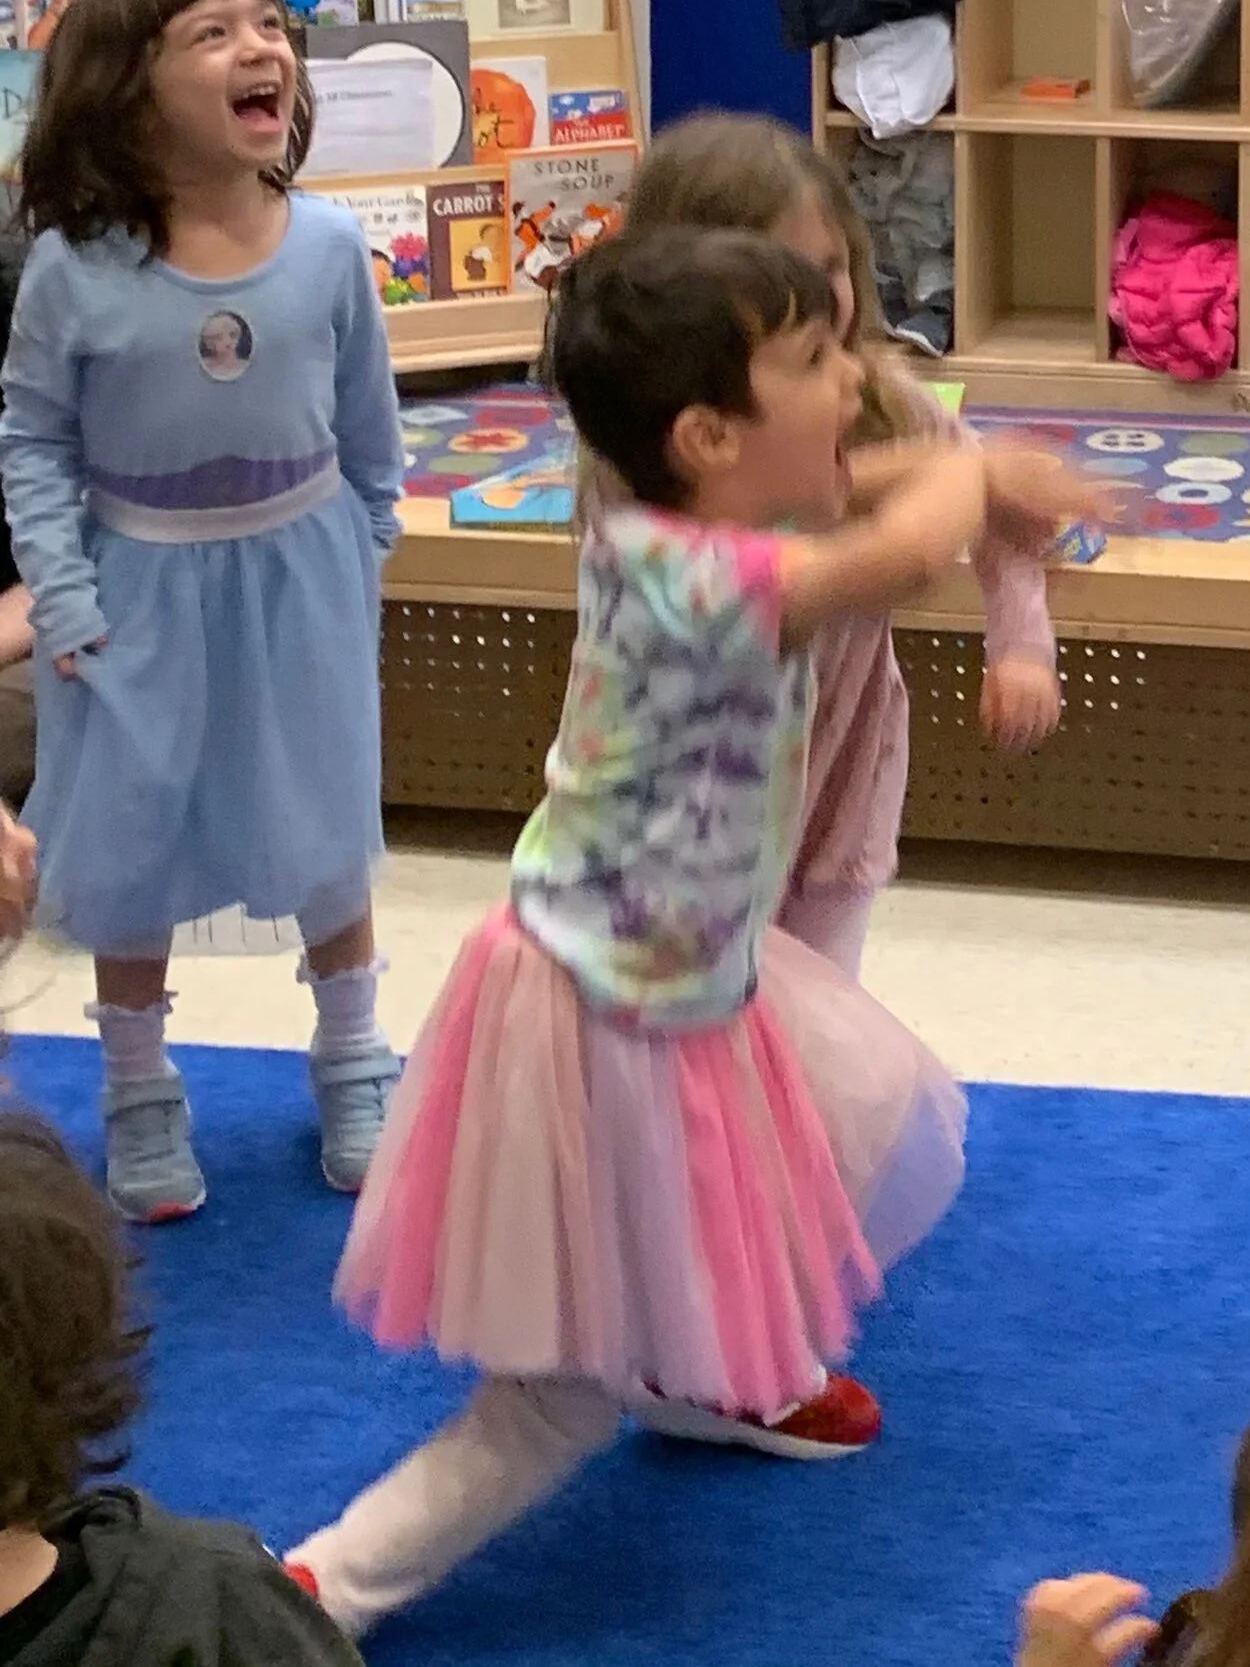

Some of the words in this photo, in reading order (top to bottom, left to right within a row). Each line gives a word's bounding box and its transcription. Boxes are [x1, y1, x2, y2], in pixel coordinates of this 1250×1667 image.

[533, 157, 600, 175] STONE
[560, 174, 614, 191] SOUP
[432, 194, 493, 217] CARROT
